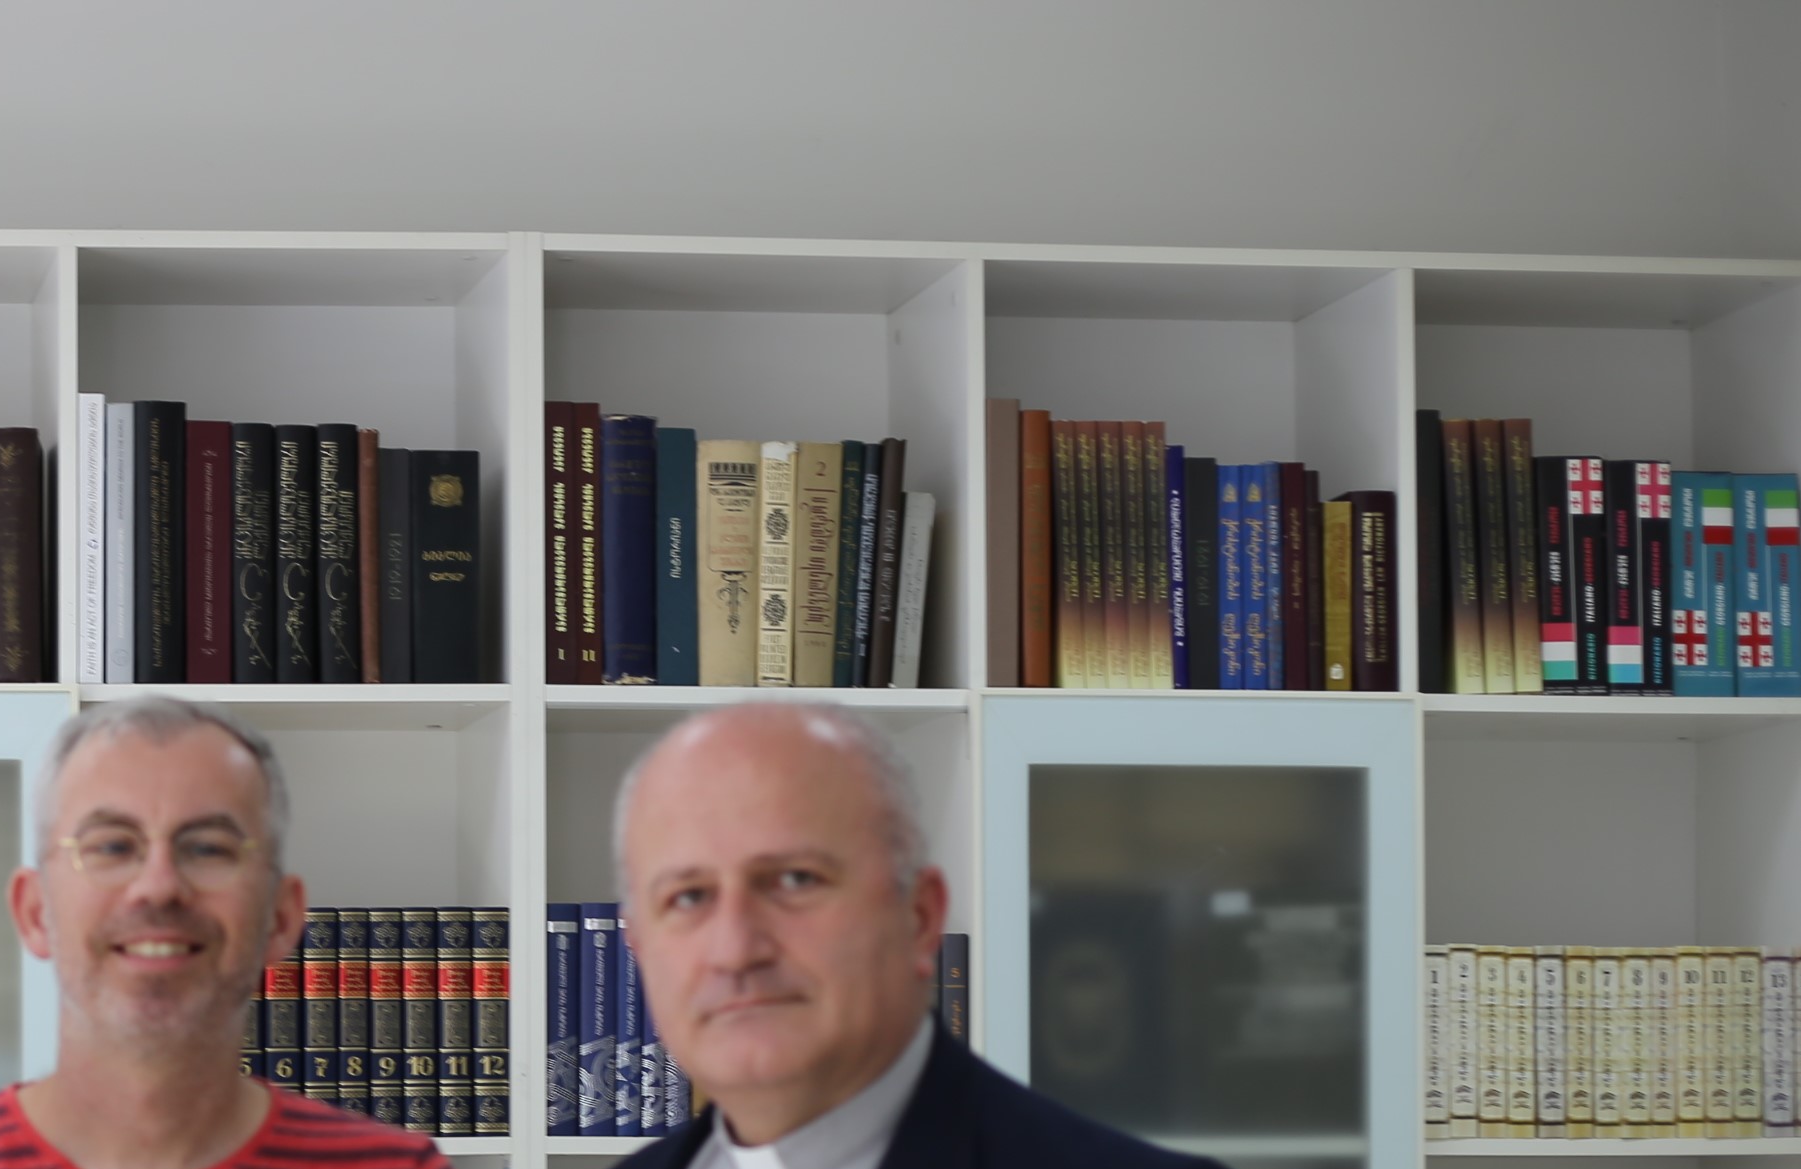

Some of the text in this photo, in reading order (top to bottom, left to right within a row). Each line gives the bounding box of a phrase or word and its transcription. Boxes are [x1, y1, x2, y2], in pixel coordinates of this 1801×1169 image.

[815, 461, 827, 477] 2
[798, 556, 834, 626] უძველესი
[1458, 962, 1469, 979] 2
[1545, 968, 1556, 986] 5
[1602, 970, 1612, 987] 7
[1631, 969, 1643, 986] 8
[1684, 970, 1700, 985] 10
[1712, 970, 1727, 985] 11
[1740, 969, 1755, 984] 12
[1770, 973, 1786, 988] 13
[274, 1057, 293, 1079] 6
[313, 1056, 328, 1078] 7
[346, 1055, 362, 1076] 8
[378, 1056, 396, 1077] 9
[407, 1055, 434, 1077] 10
[445, 1055, 469, 1077] 11
[479, 1055, 506, 1077] 12
